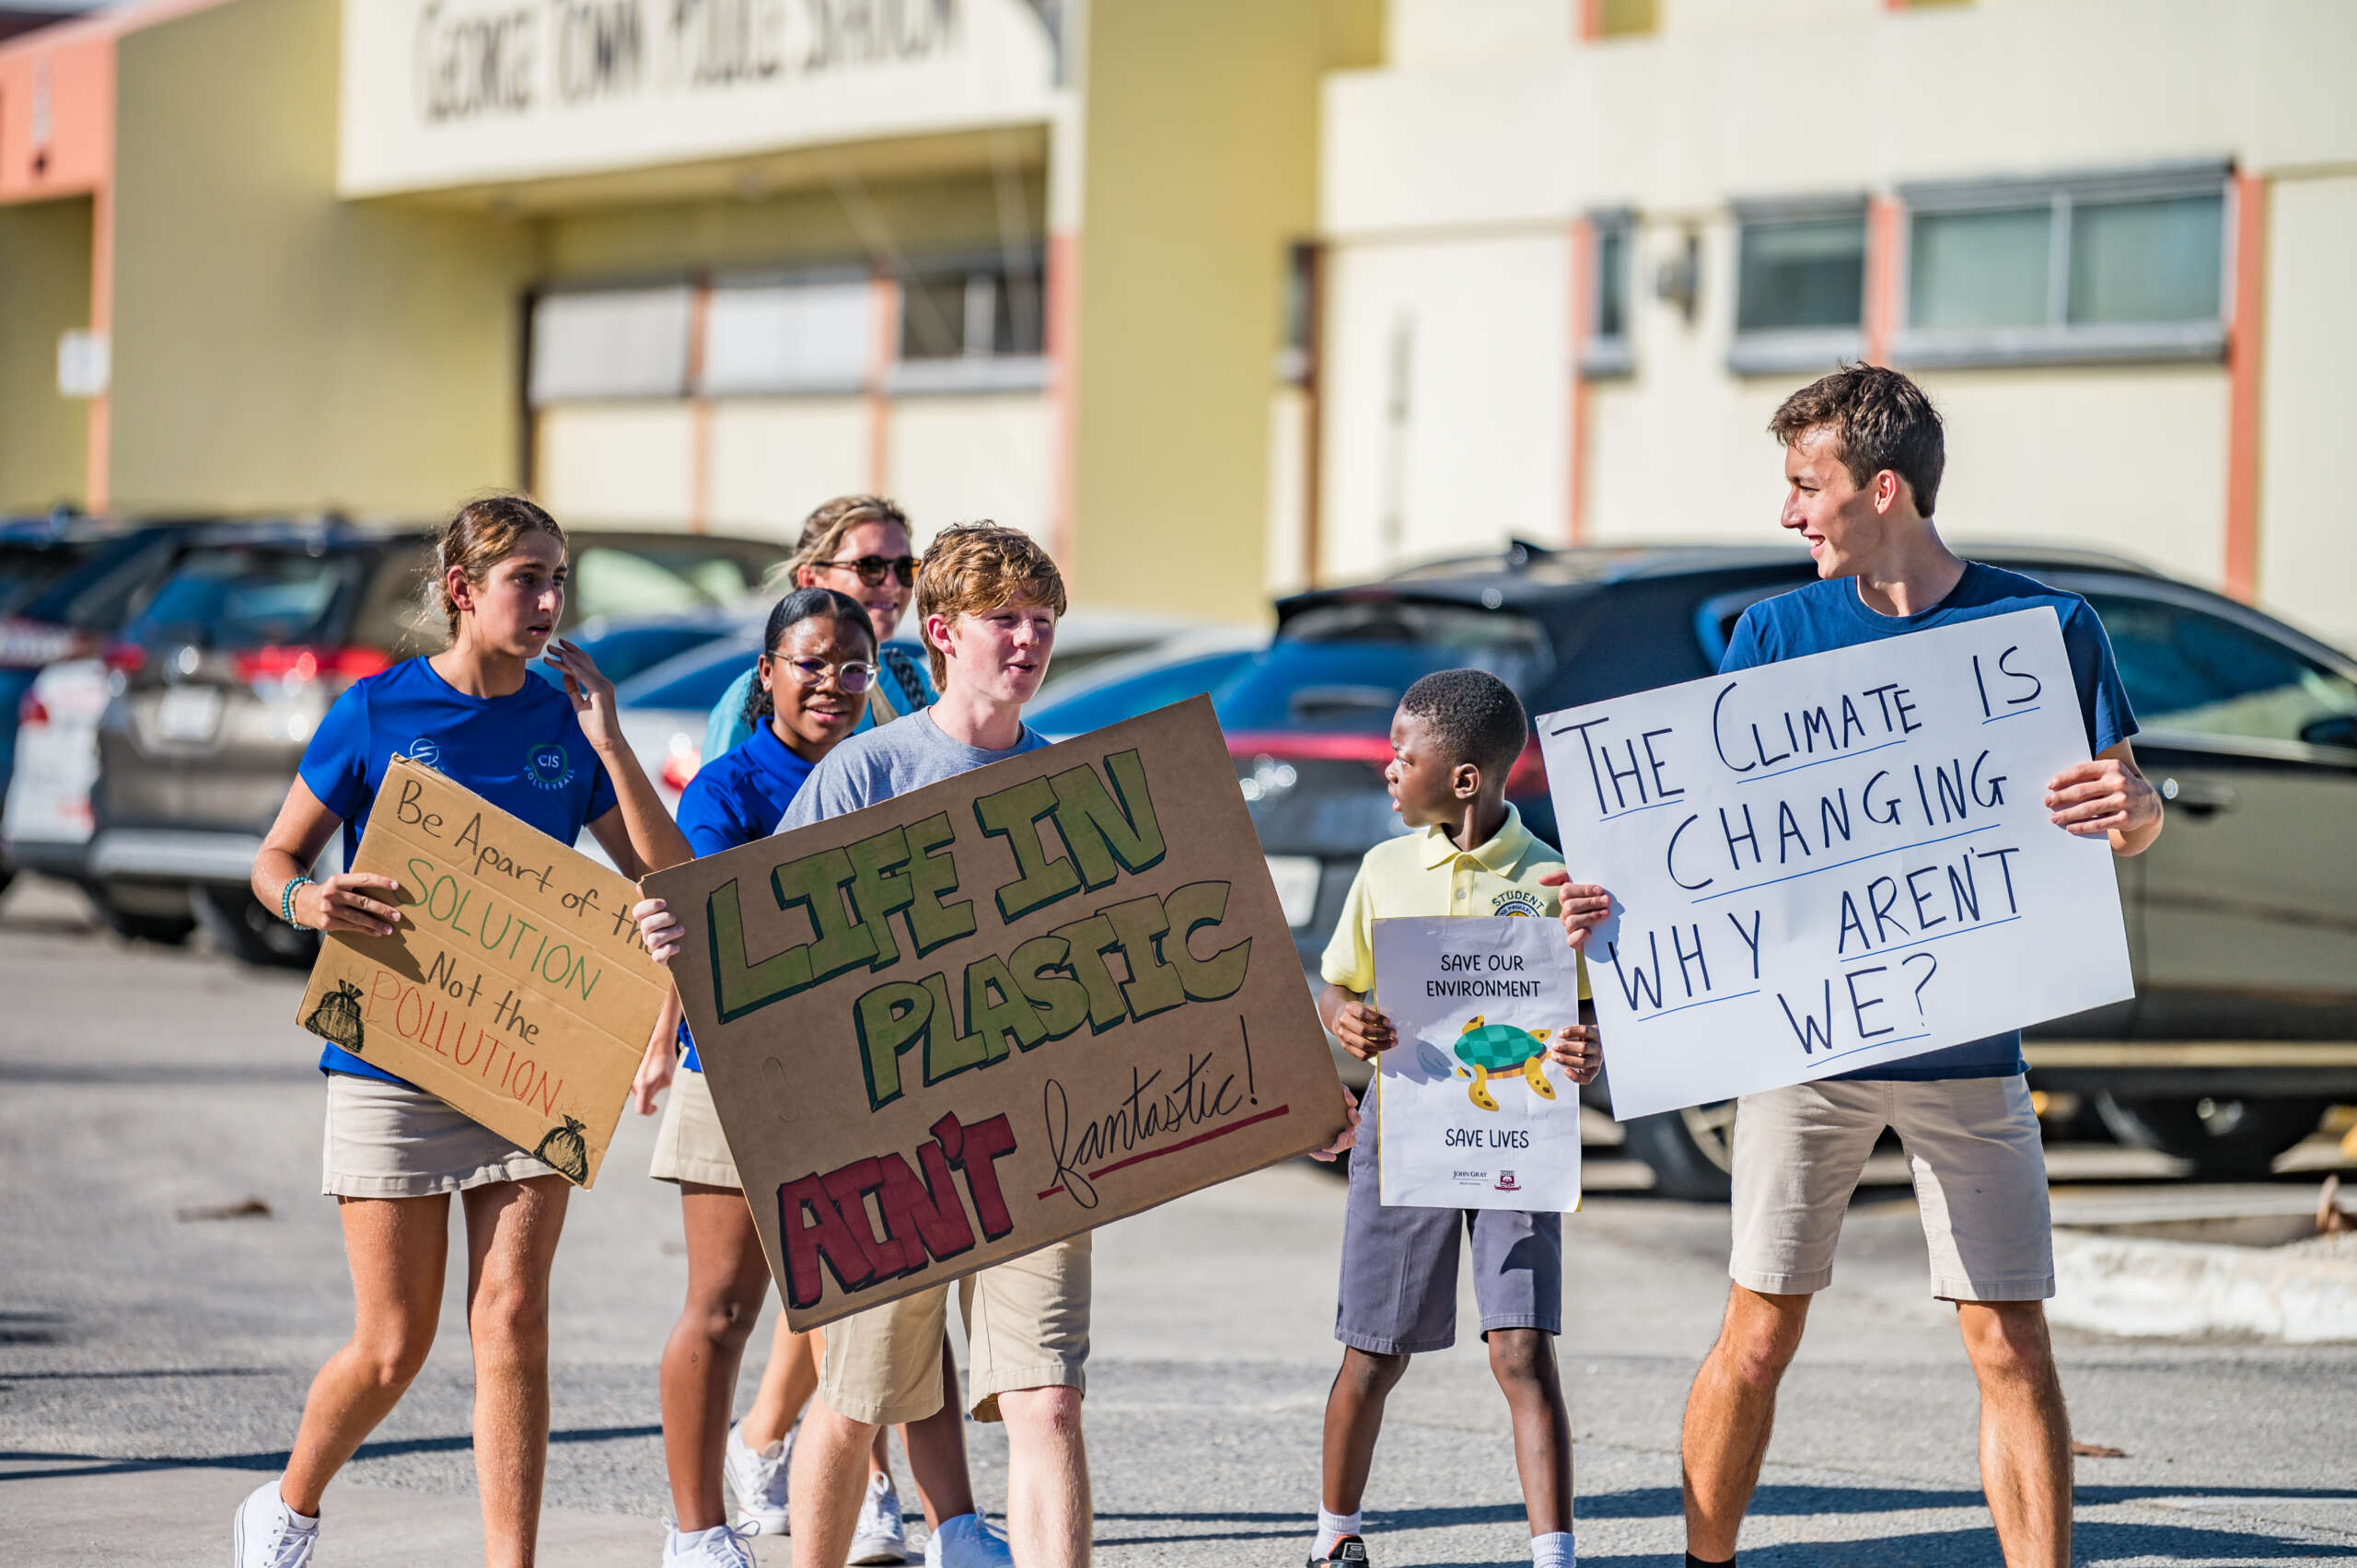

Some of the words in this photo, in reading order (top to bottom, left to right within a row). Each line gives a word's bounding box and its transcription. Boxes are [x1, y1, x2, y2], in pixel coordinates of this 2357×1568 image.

[538, 755, 559, 768] CIS
[1551, 717, 1685, 815] THE
[1713, 682, 1922, 772] CLIMATE
[1972, 645, 2042, 718] IS
[397, 780, 443, 839] Be
[562, 889, 601, 918] of
[707, 810, 977, 1025] LIFE
[972, 748, 1166, 925] IN
[1667, 749, 2007, 891] CHANGING
[396, 858, 601, 1002] SOLUTION
[1441, 954, 1481, 972] SAVE
[1488, 954, 1524, 971] OUR
[1492, 890, 1545, 911] STUDENT
[1608, 911, 1761, 1012] WHY
[1838, 847, 2020, 955] AREN'T
[366, 970, 563, 1118] POLLUTION
[427, 951, 482, 1007] Not
[493, 991, 540, 1045] the
[853, 881, 1252, 1111] PLASTIC
[1426, 981, 1540, 998] ENVIRONMENT
[1777, 953, 1937, 1055] WE?
[777, 1111, 1016, 1310] AIN'T
[1044, 1015, 1258, 1208] fantastic!
[1446, 1129, 1484, 1148] SAVE
[1490, 1130, 1529, 1149] LIVES
